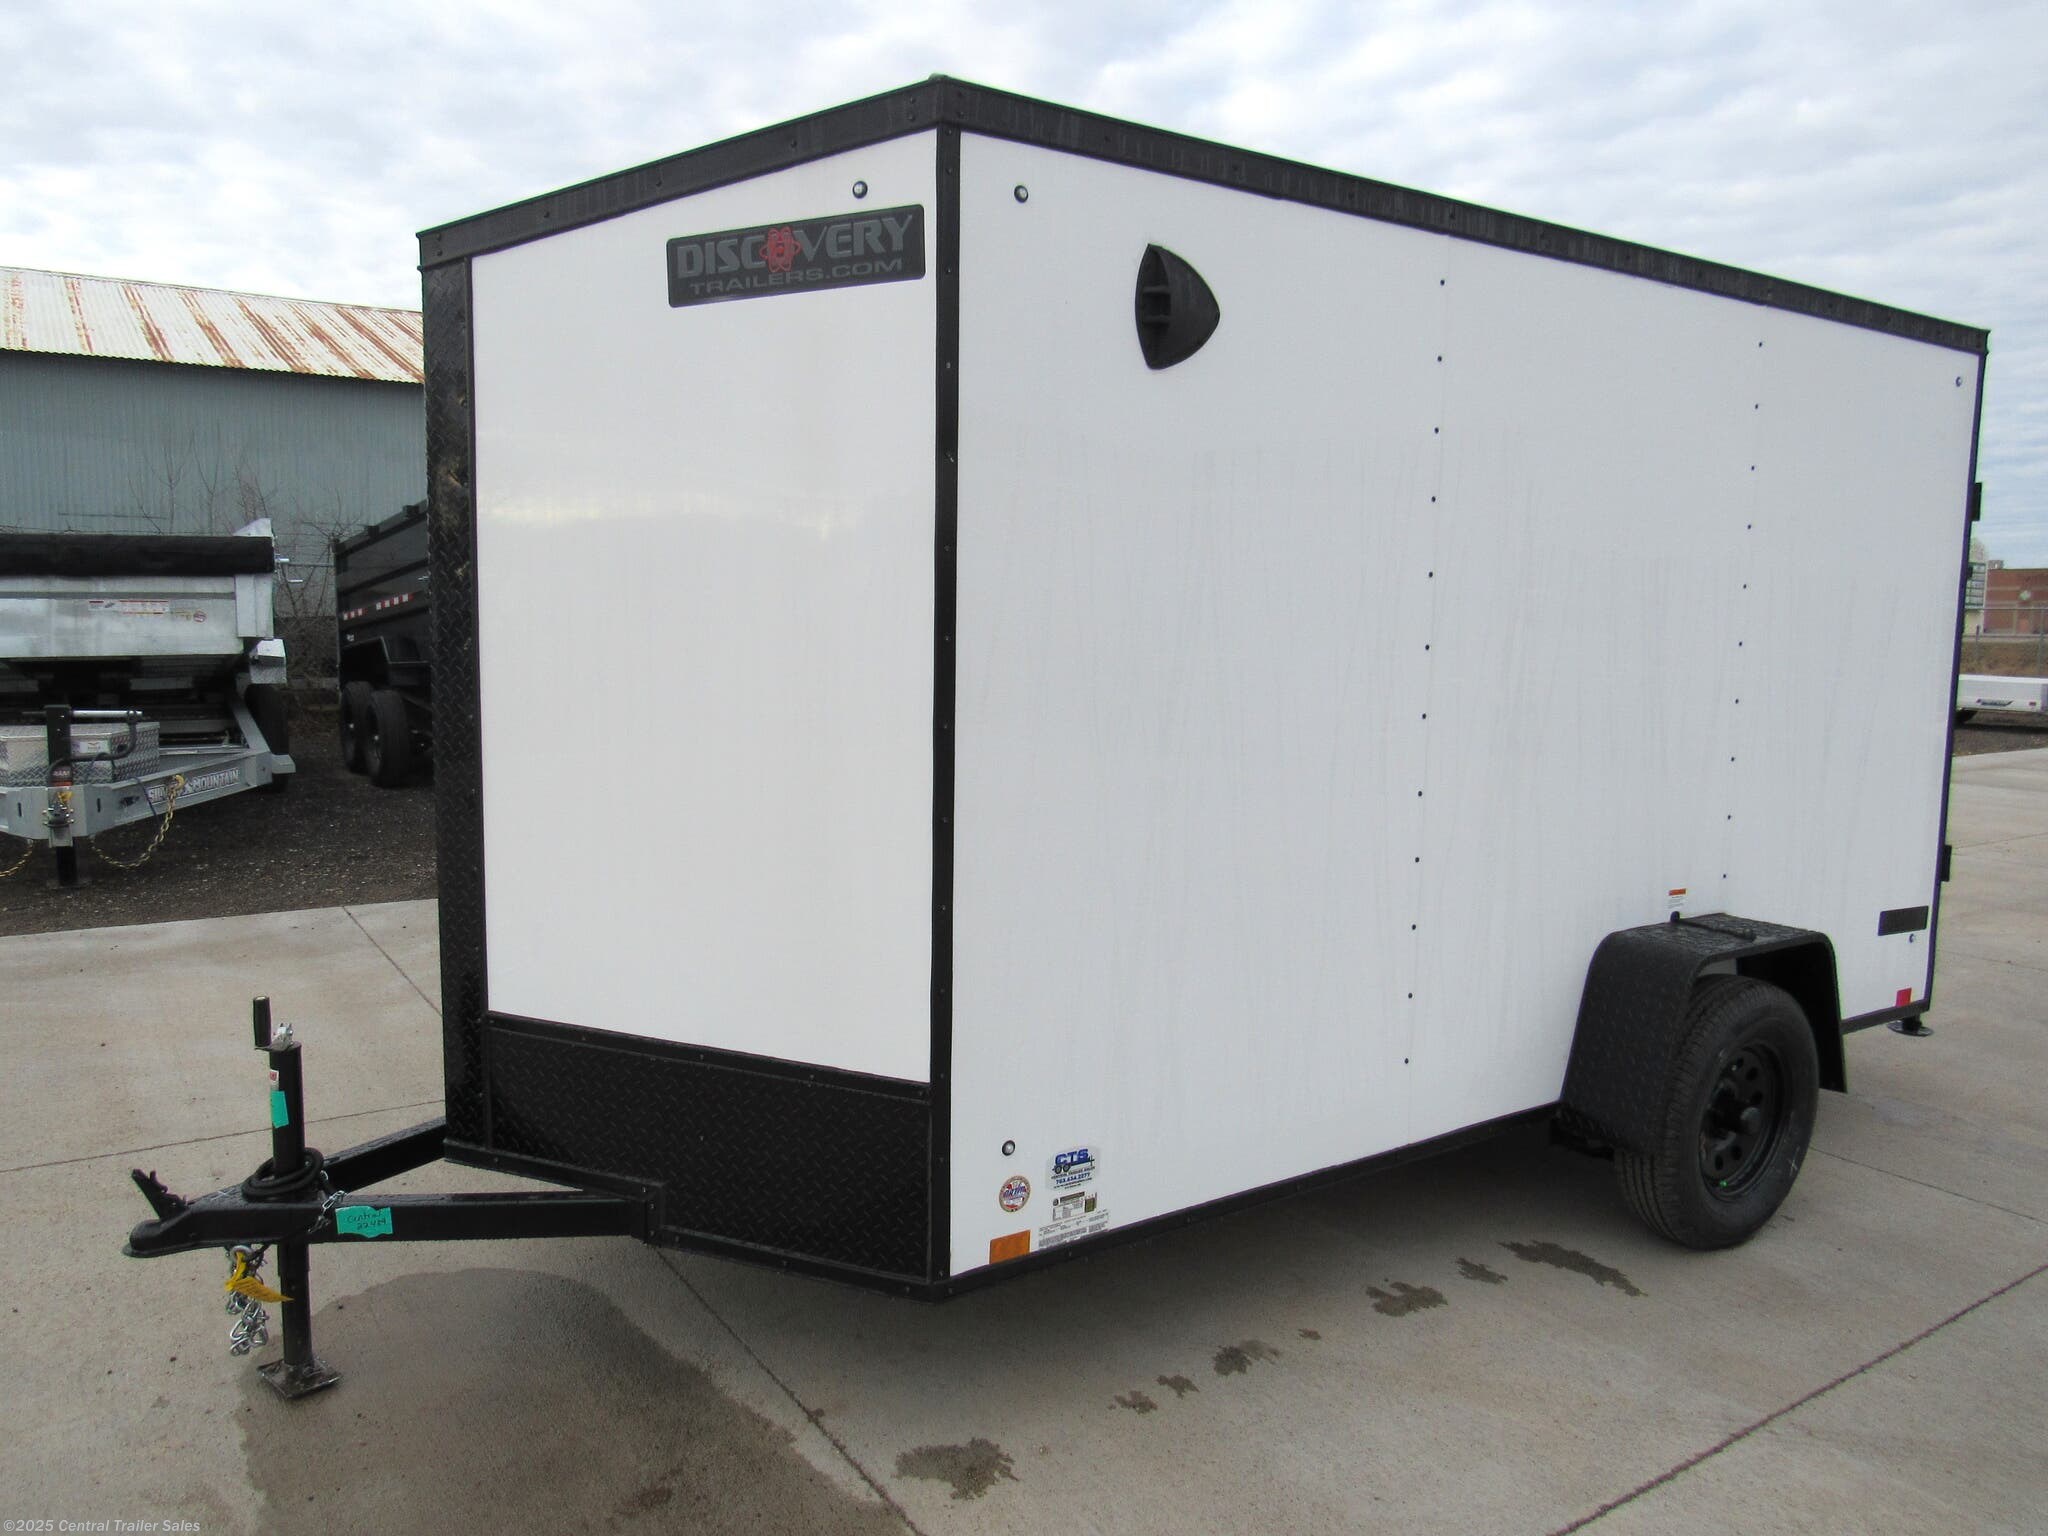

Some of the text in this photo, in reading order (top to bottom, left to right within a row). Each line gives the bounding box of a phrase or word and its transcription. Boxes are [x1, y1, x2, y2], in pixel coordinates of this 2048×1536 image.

[677, 214, 913, 279] DISCOVERY
[689, 258, 902, 295] TRAILERS.COM
[192, 767, 240, 793] MOUNTAIN
[1055, 1148, 1089, 1165] CTS
